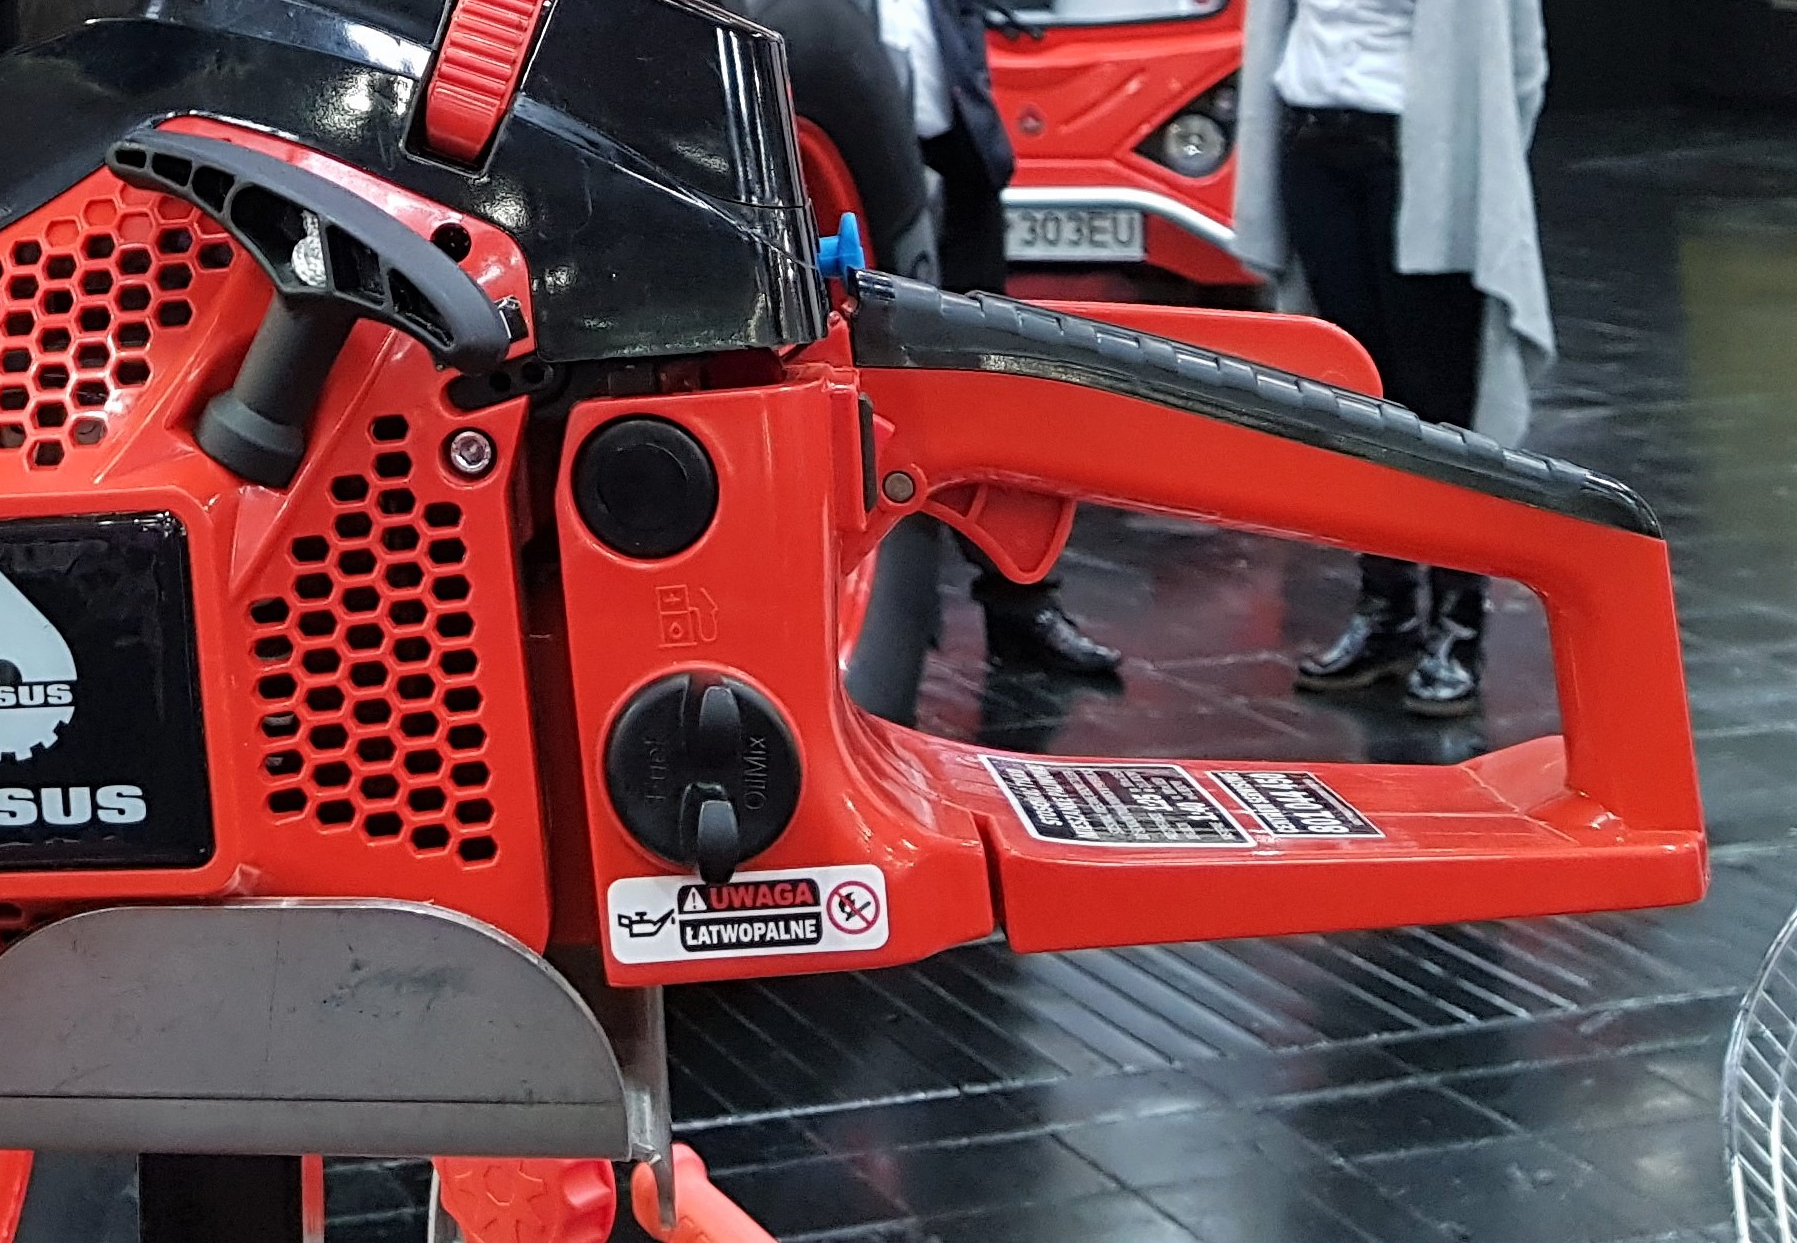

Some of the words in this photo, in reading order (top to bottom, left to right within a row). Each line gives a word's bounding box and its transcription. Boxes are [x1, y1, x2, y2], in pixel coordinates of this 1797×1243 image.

[1246, 773, 1302, 789] 450
[1266, 790, 1326, 809] 044
[1288, 810, 1353, 832] 801
[710, 882, 814, 909] UWAGA
[685, 919, 818, 947] ŁATWOPALNE
